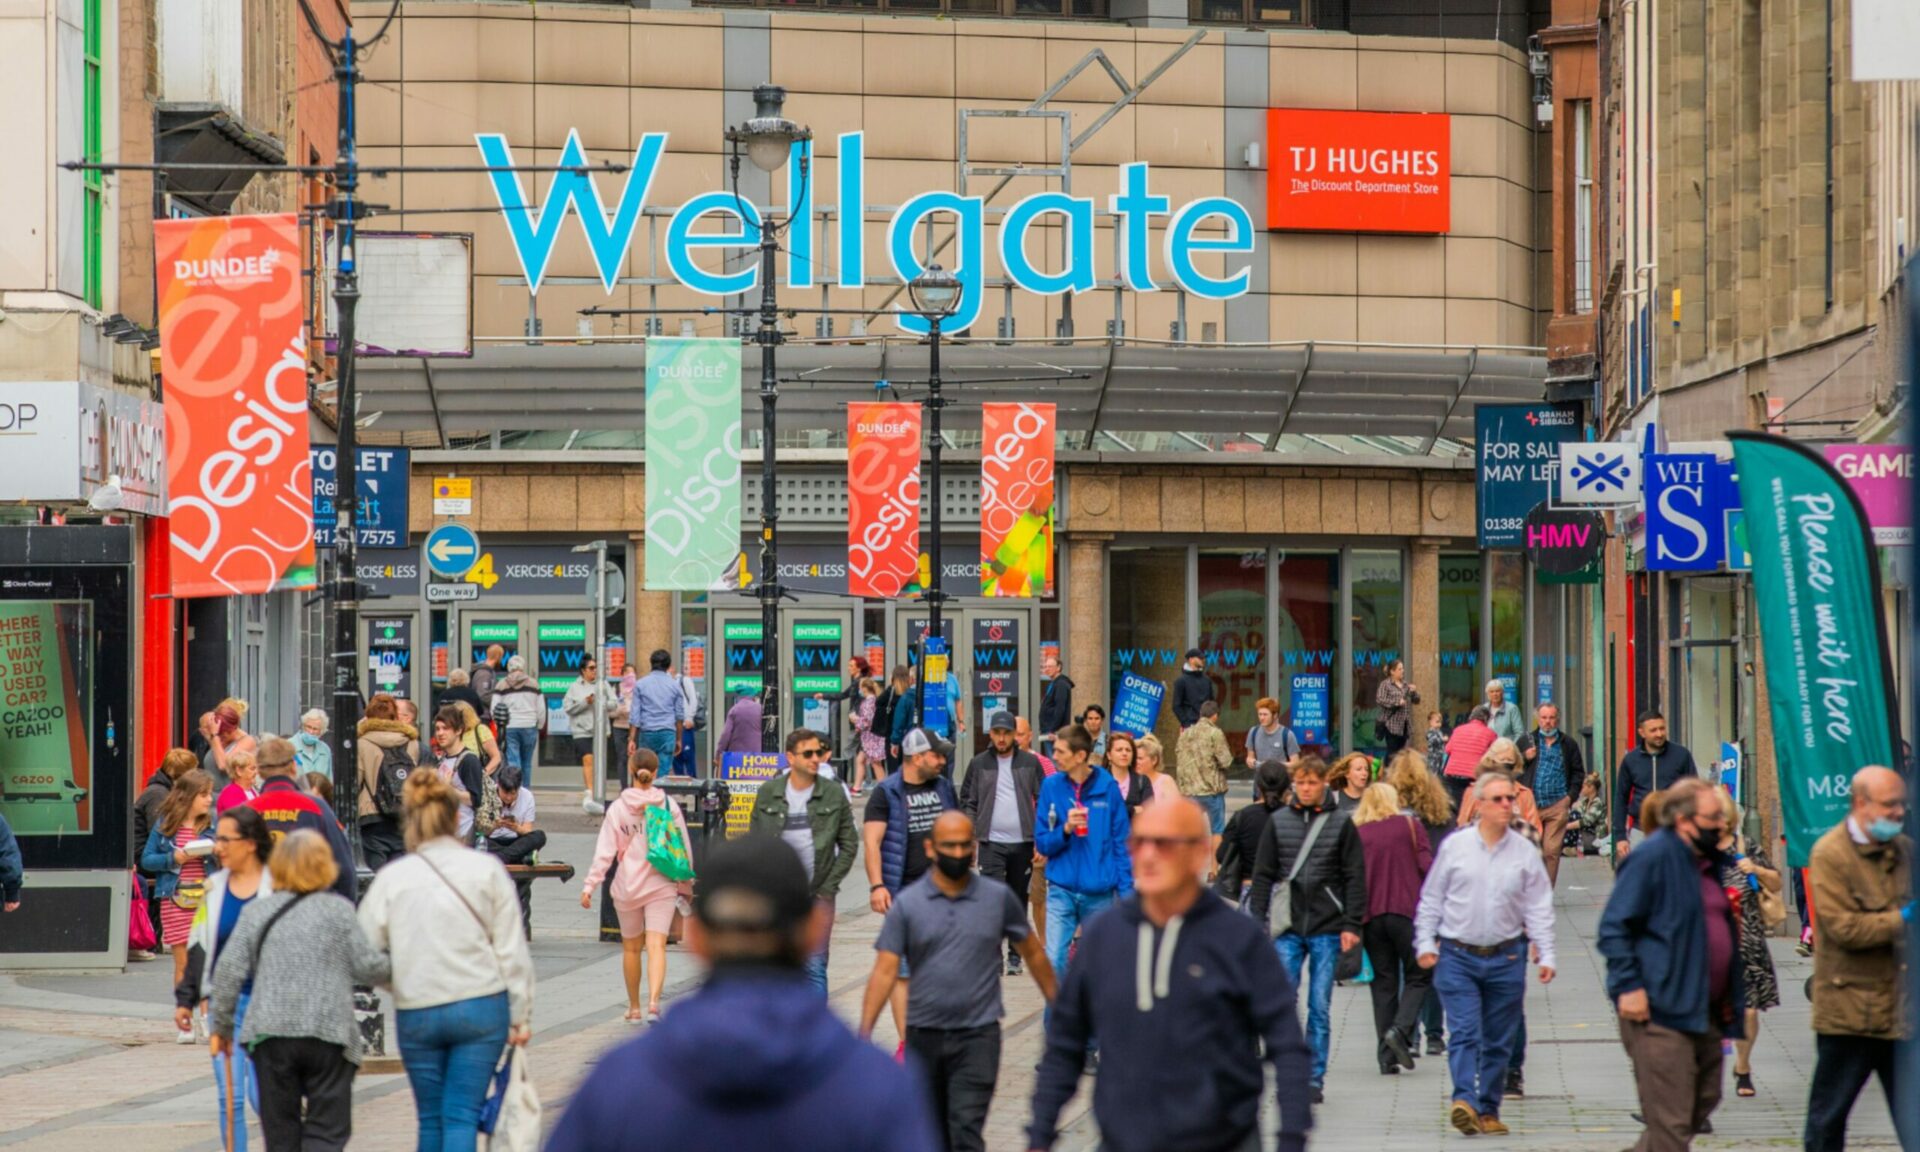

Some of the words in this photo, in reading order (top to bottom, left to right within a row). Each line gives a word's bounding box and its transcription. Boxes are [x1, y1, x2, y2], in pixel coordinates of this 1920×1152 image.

[1290, 147, 1316, 172] TJ
[1328, 148, 1439, 176] HUGHES
[1291, 179, 1309, 193] The
[1311, 179, 1352, 191] Discount
[1355, 180, 1411, 194] Department
[1413, 182, 1439, 194] Store
[474, 127, 1255, 335] Wellgate
[174, 255, 273, 279] DUNDEE
[658, 364, 723, 378] DUNDEE
[857, 423, 907, 434] DUNDEE
[1539, 418, 1575, 426] SIBBALD
[1484, 443, 1520, 459] FOR
[1526, 442, 1560, 459] SAL
[308, 450, 337, 471] TO
[354, 451, 393, 472] ET
[1834, 453, 1915, 478] GAME
[1484, 465, 1525, 482] MAY
[1531, 464, 1560, 481] LET
[1656, 462, 1704, 483] WH
[1485, 518, 1523, 530] 01382
[1657, 484, 1708, 562] S
[360, 530, 396, 545] 7575
[1527, 523, 1592, 548] HMV
[1791, 492, 1836, 593] Please
[356, 565, 417, 578] RCISE4LESS
[505, 565, 590, 578] XERCISE4LESS
[776, 564, 846, 577] RCISE4LESS
[430, 587, 450, 597] One
[454, 588, 475, 598] way
[474, 628, 516, 637] ENTRANCE
[541, 628, 583, 637] ENTRANCE
[796, 627, 838, 636] ENTRANCE
[1814, 603, 1852, 668] wait
[7, 646, 42, 661] WAY
[12, 660, 44, 676] BUY
[4, 675, 46, 691] USED
[796, 680, 838, 688] ENTRANCE
[1124, 675, 1163, 698] OPEN!
[1293, 677, 1326, 688] OPEN!
[5, 690, 47, 706] CAR?
[1130, 693, 1149, 706] THIS
[1301, 693, 1318, 701] THIS
[1124, 701, 1150, 715] STORE
[1298, 701, 1321, 710] STORE
[1815, 677, 1858, 744] here
[2, 706, 64, 725] CAZOO
[1129, 712, 1150, 724] NOW
[1305, 710, 1322, 718] NOW
[1801, 705, 1813, 725] FOR
[4, 722, 52, 739] YEAH!
[1293, 719, 1326, 728] RE-OPEN!
[1804, 727, 1816, 748] YOU
[743, 755, 779, 767] HOME
[1807, 774, 1853, 800] M&
